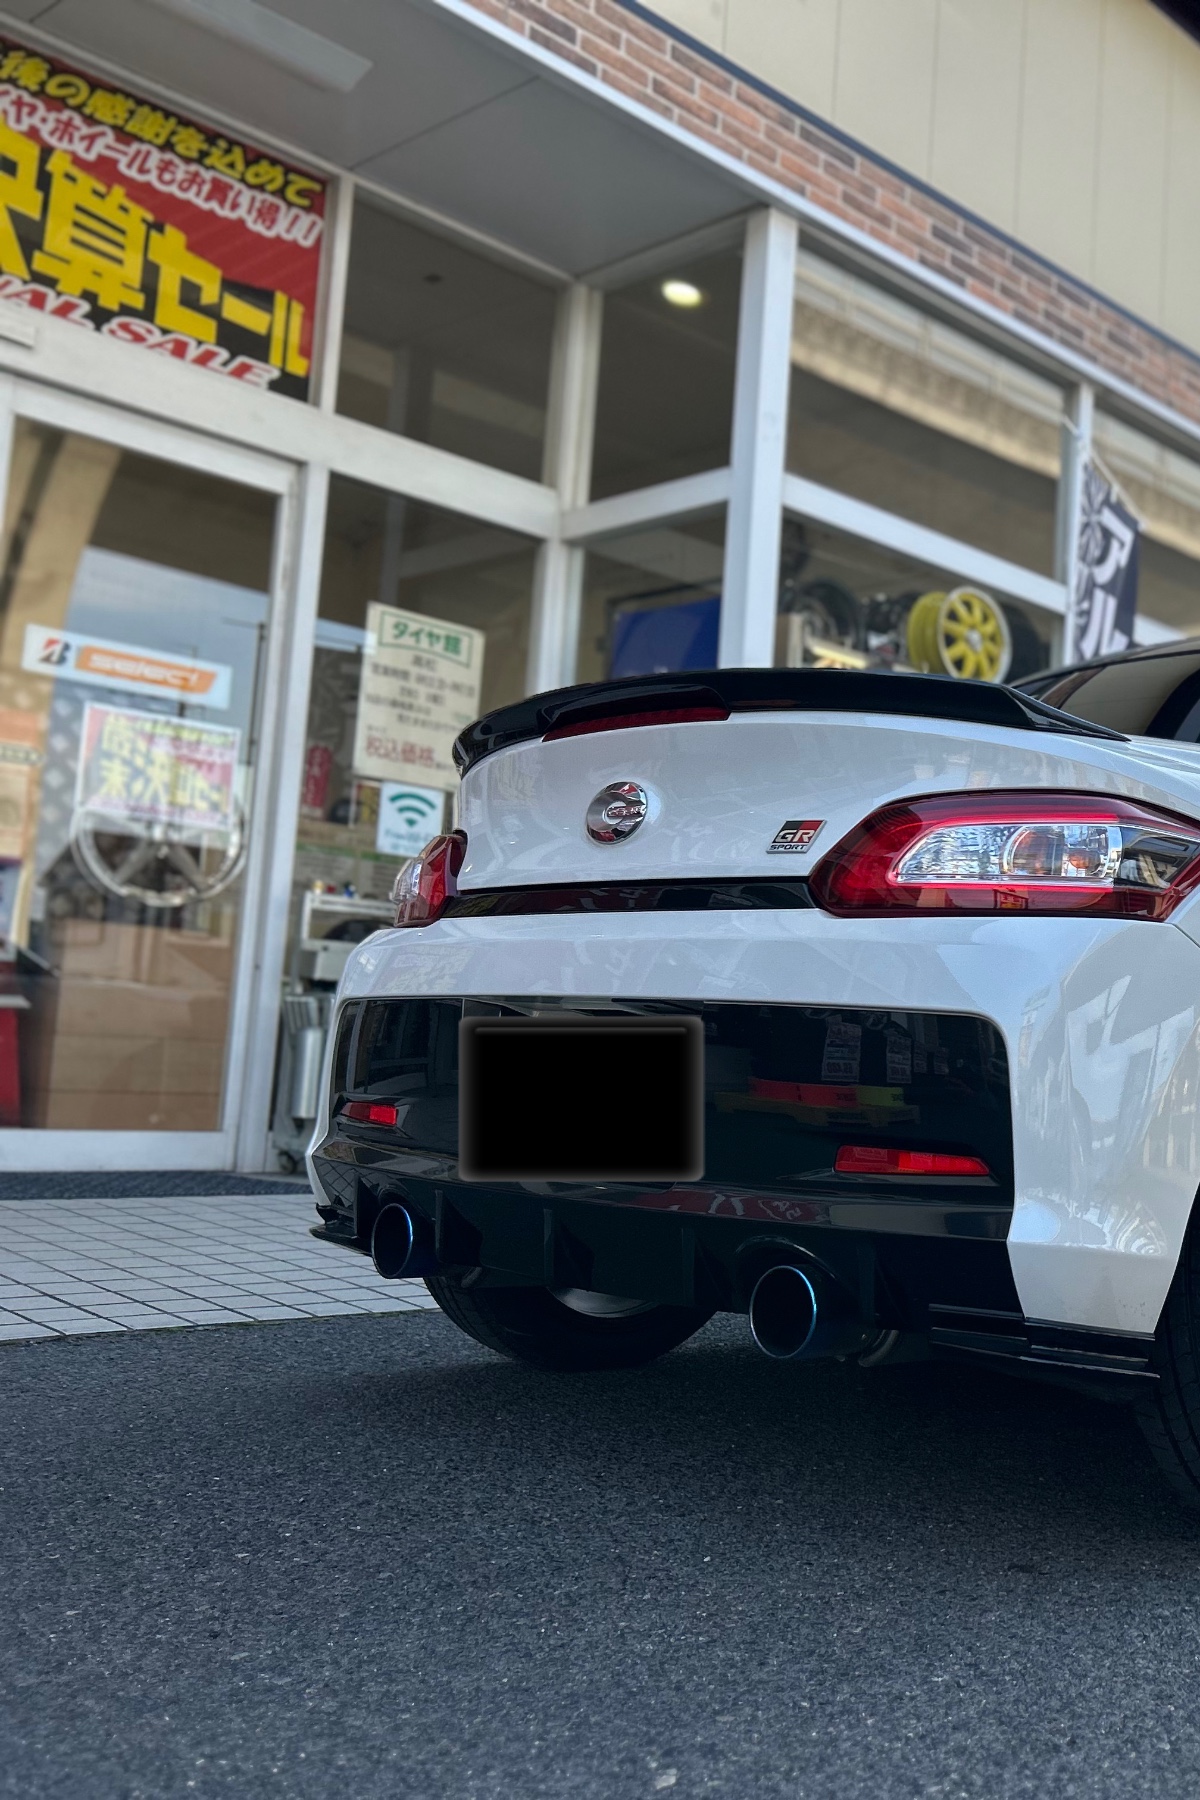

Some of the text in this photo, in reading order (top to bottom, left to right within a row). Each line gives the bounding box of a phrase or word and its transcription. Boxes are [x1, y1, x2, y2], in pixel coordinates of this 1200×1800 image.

[0, 48, 323, 207] 後の感謝を込めて
[104, 315, 280, 390] SALE
[769, 843, 808, 852] SPORT
[774, 829, 816, 844] GR
